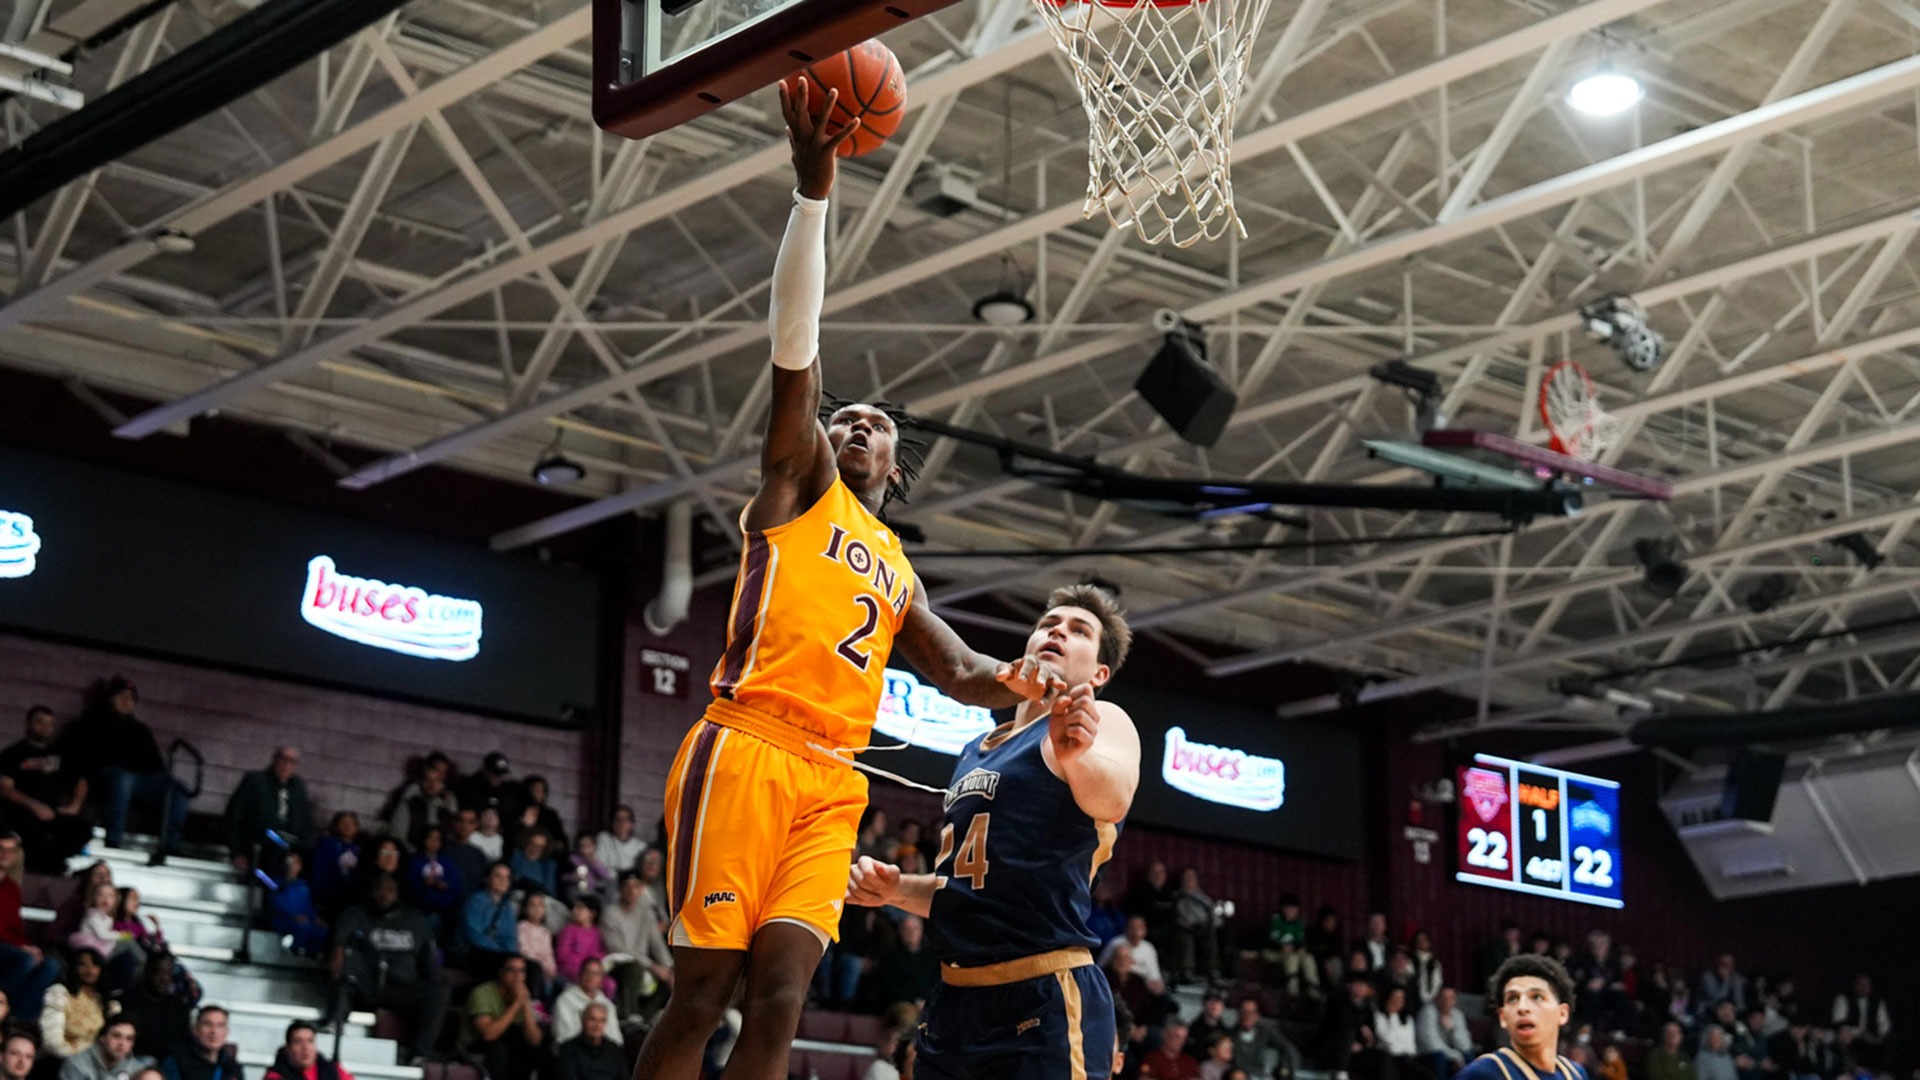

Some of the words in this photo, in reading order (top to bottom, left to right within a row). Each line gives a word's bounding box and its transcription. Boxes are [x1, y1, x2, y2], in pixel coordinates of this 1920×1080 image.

[820, 522, 912, 618] IONA
[835, 593, 881, 674] 2
[652, 667, 677, 695] 12
[960, 774, 998, 794] MOUNT
[1531, 808, 1547, 842] 1
[1466, 827, 1509, 871] 22
[1573, 845, 1614, 889] 22
[703, 891, 736, 909] MAAC
